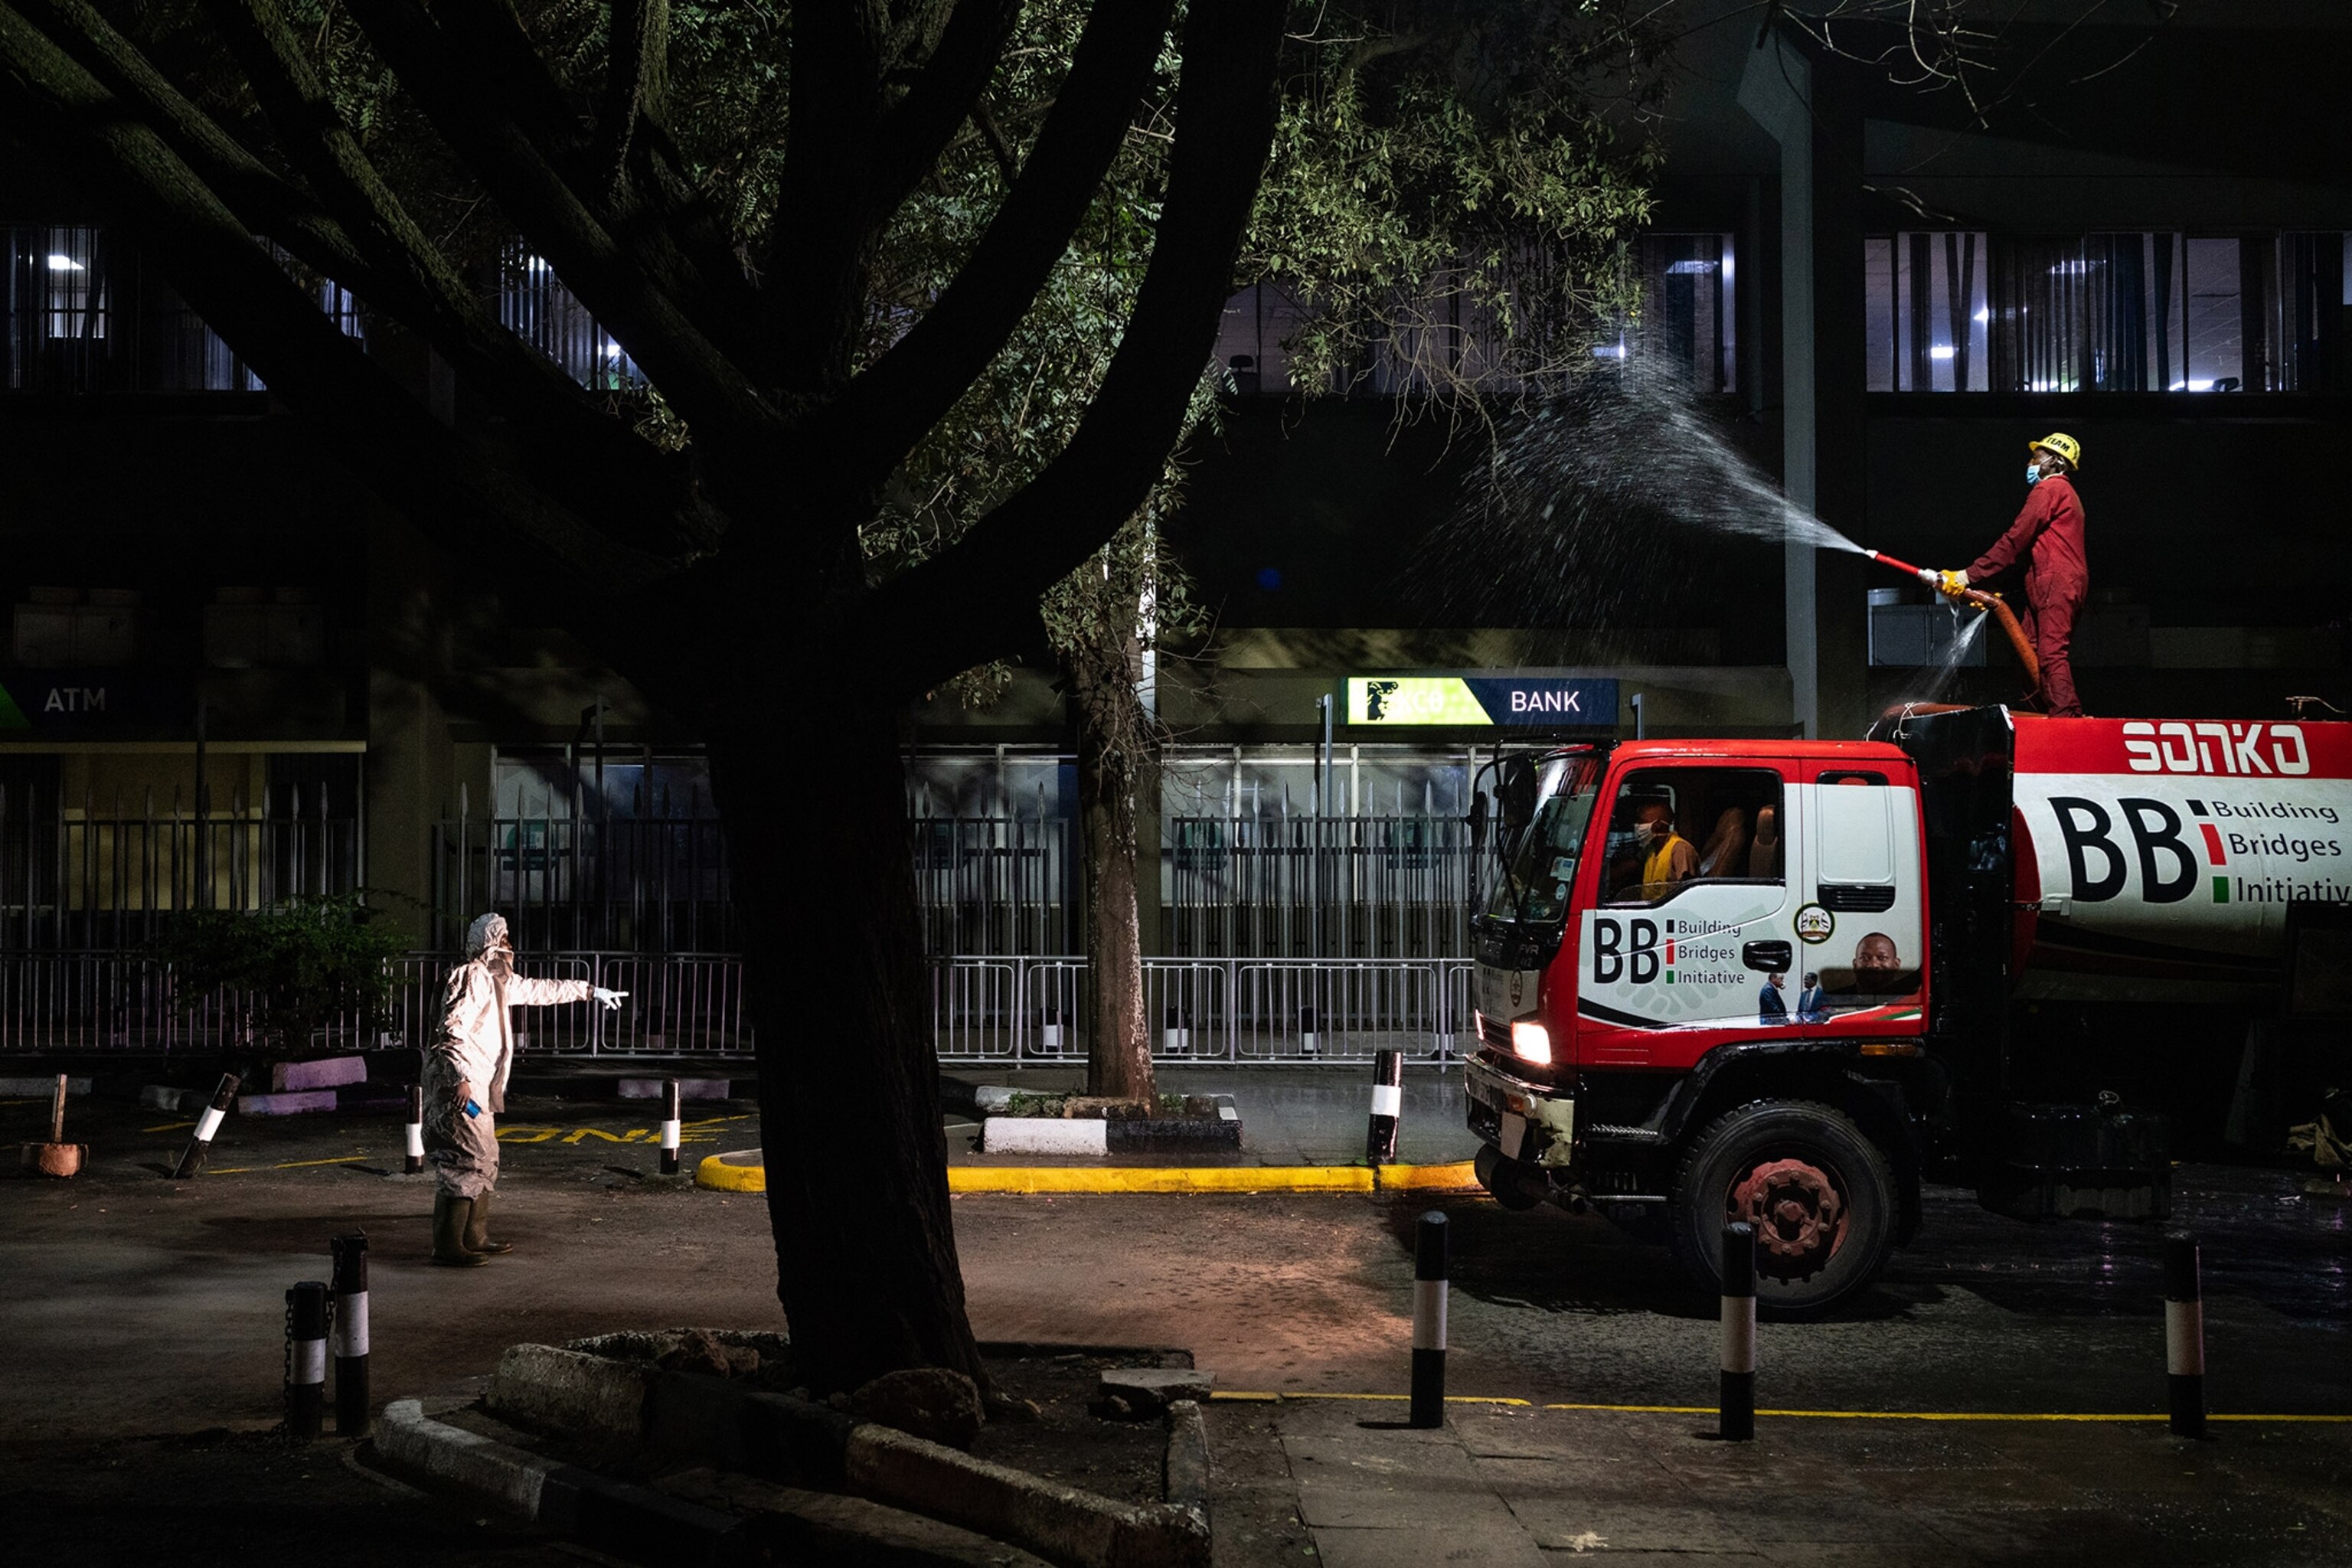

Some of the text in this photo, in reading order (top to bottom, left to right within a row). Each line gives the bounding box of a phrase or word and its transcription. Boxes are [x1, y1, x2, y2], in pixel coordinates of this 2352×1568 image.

[2047, 437, 2070, 452] TEAM
[44, 688, 106, 712] ATM
[1397, 691, 1580, 714] KCB BANK
[2122, 722, 2311, 775] SONKO
[2211, 801, 2340, 824] Building
[2228, 833, 2342, 862] Bridges
[1678, 920, 1741, 938] Building
[1678, 945, 1735, 962] Bridges
[1678, 970, 1745, 984] Initiative
